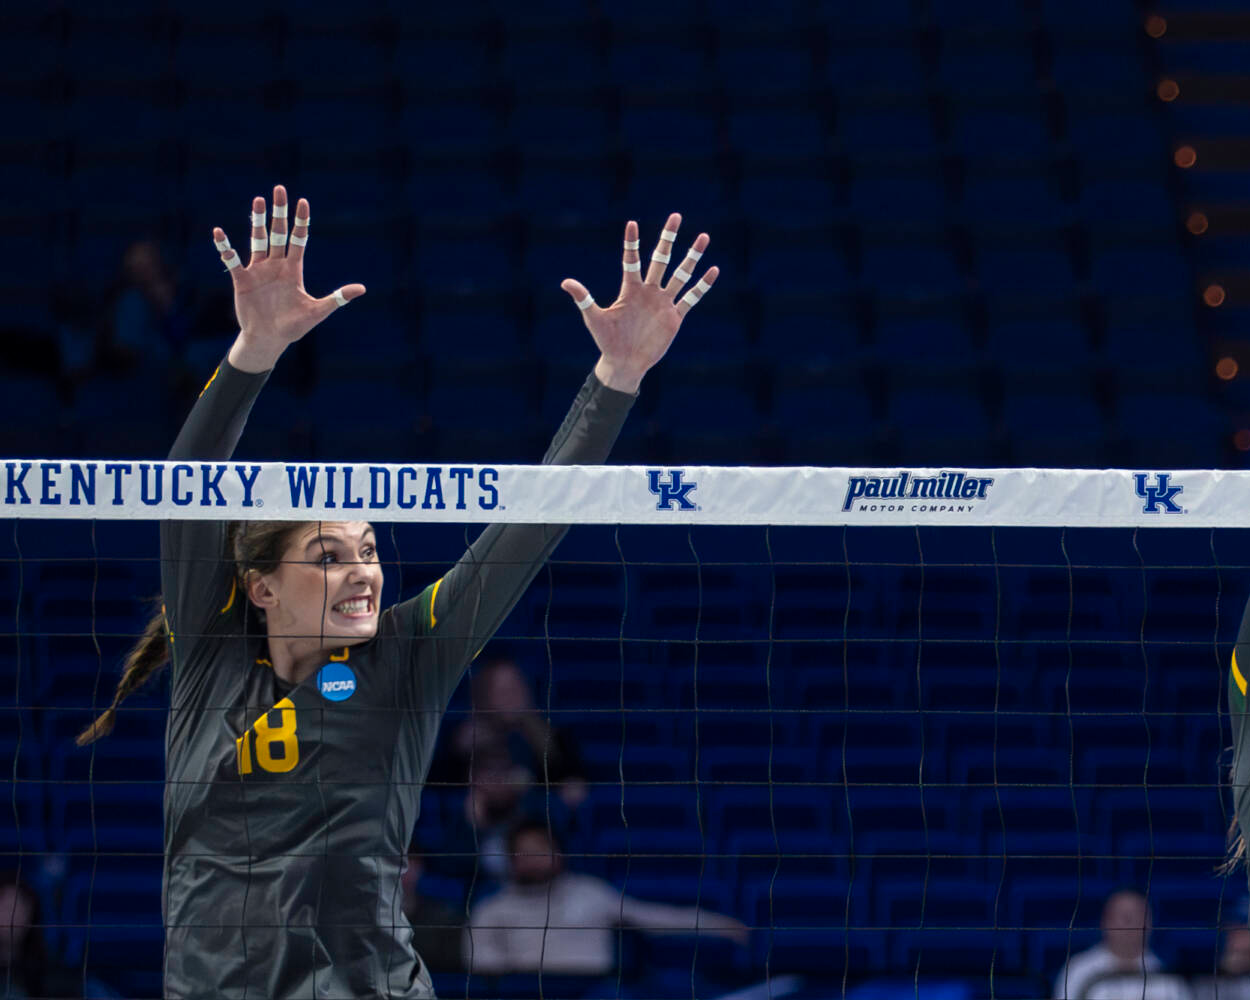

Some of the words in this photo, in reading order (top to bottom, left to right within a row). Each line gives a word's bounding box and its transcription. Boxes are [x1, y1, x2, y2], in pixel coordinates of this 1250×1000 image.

[5, 462, 262, 507] KENTUCKY
[286, 465, 500, 511] WILDCATS
[647, 469, 697, 512] UK
[842, 470, 910, 512] paul
[910, 470, 994, 500] miller
[1134, 472, 1184, 514] UK
[859, 504, 904, 513] MOTOR
[911, 504, 974, 513] COMPANY
[322, 680, 356, 693] NCAA
[236, 697, 300, 775] 18
